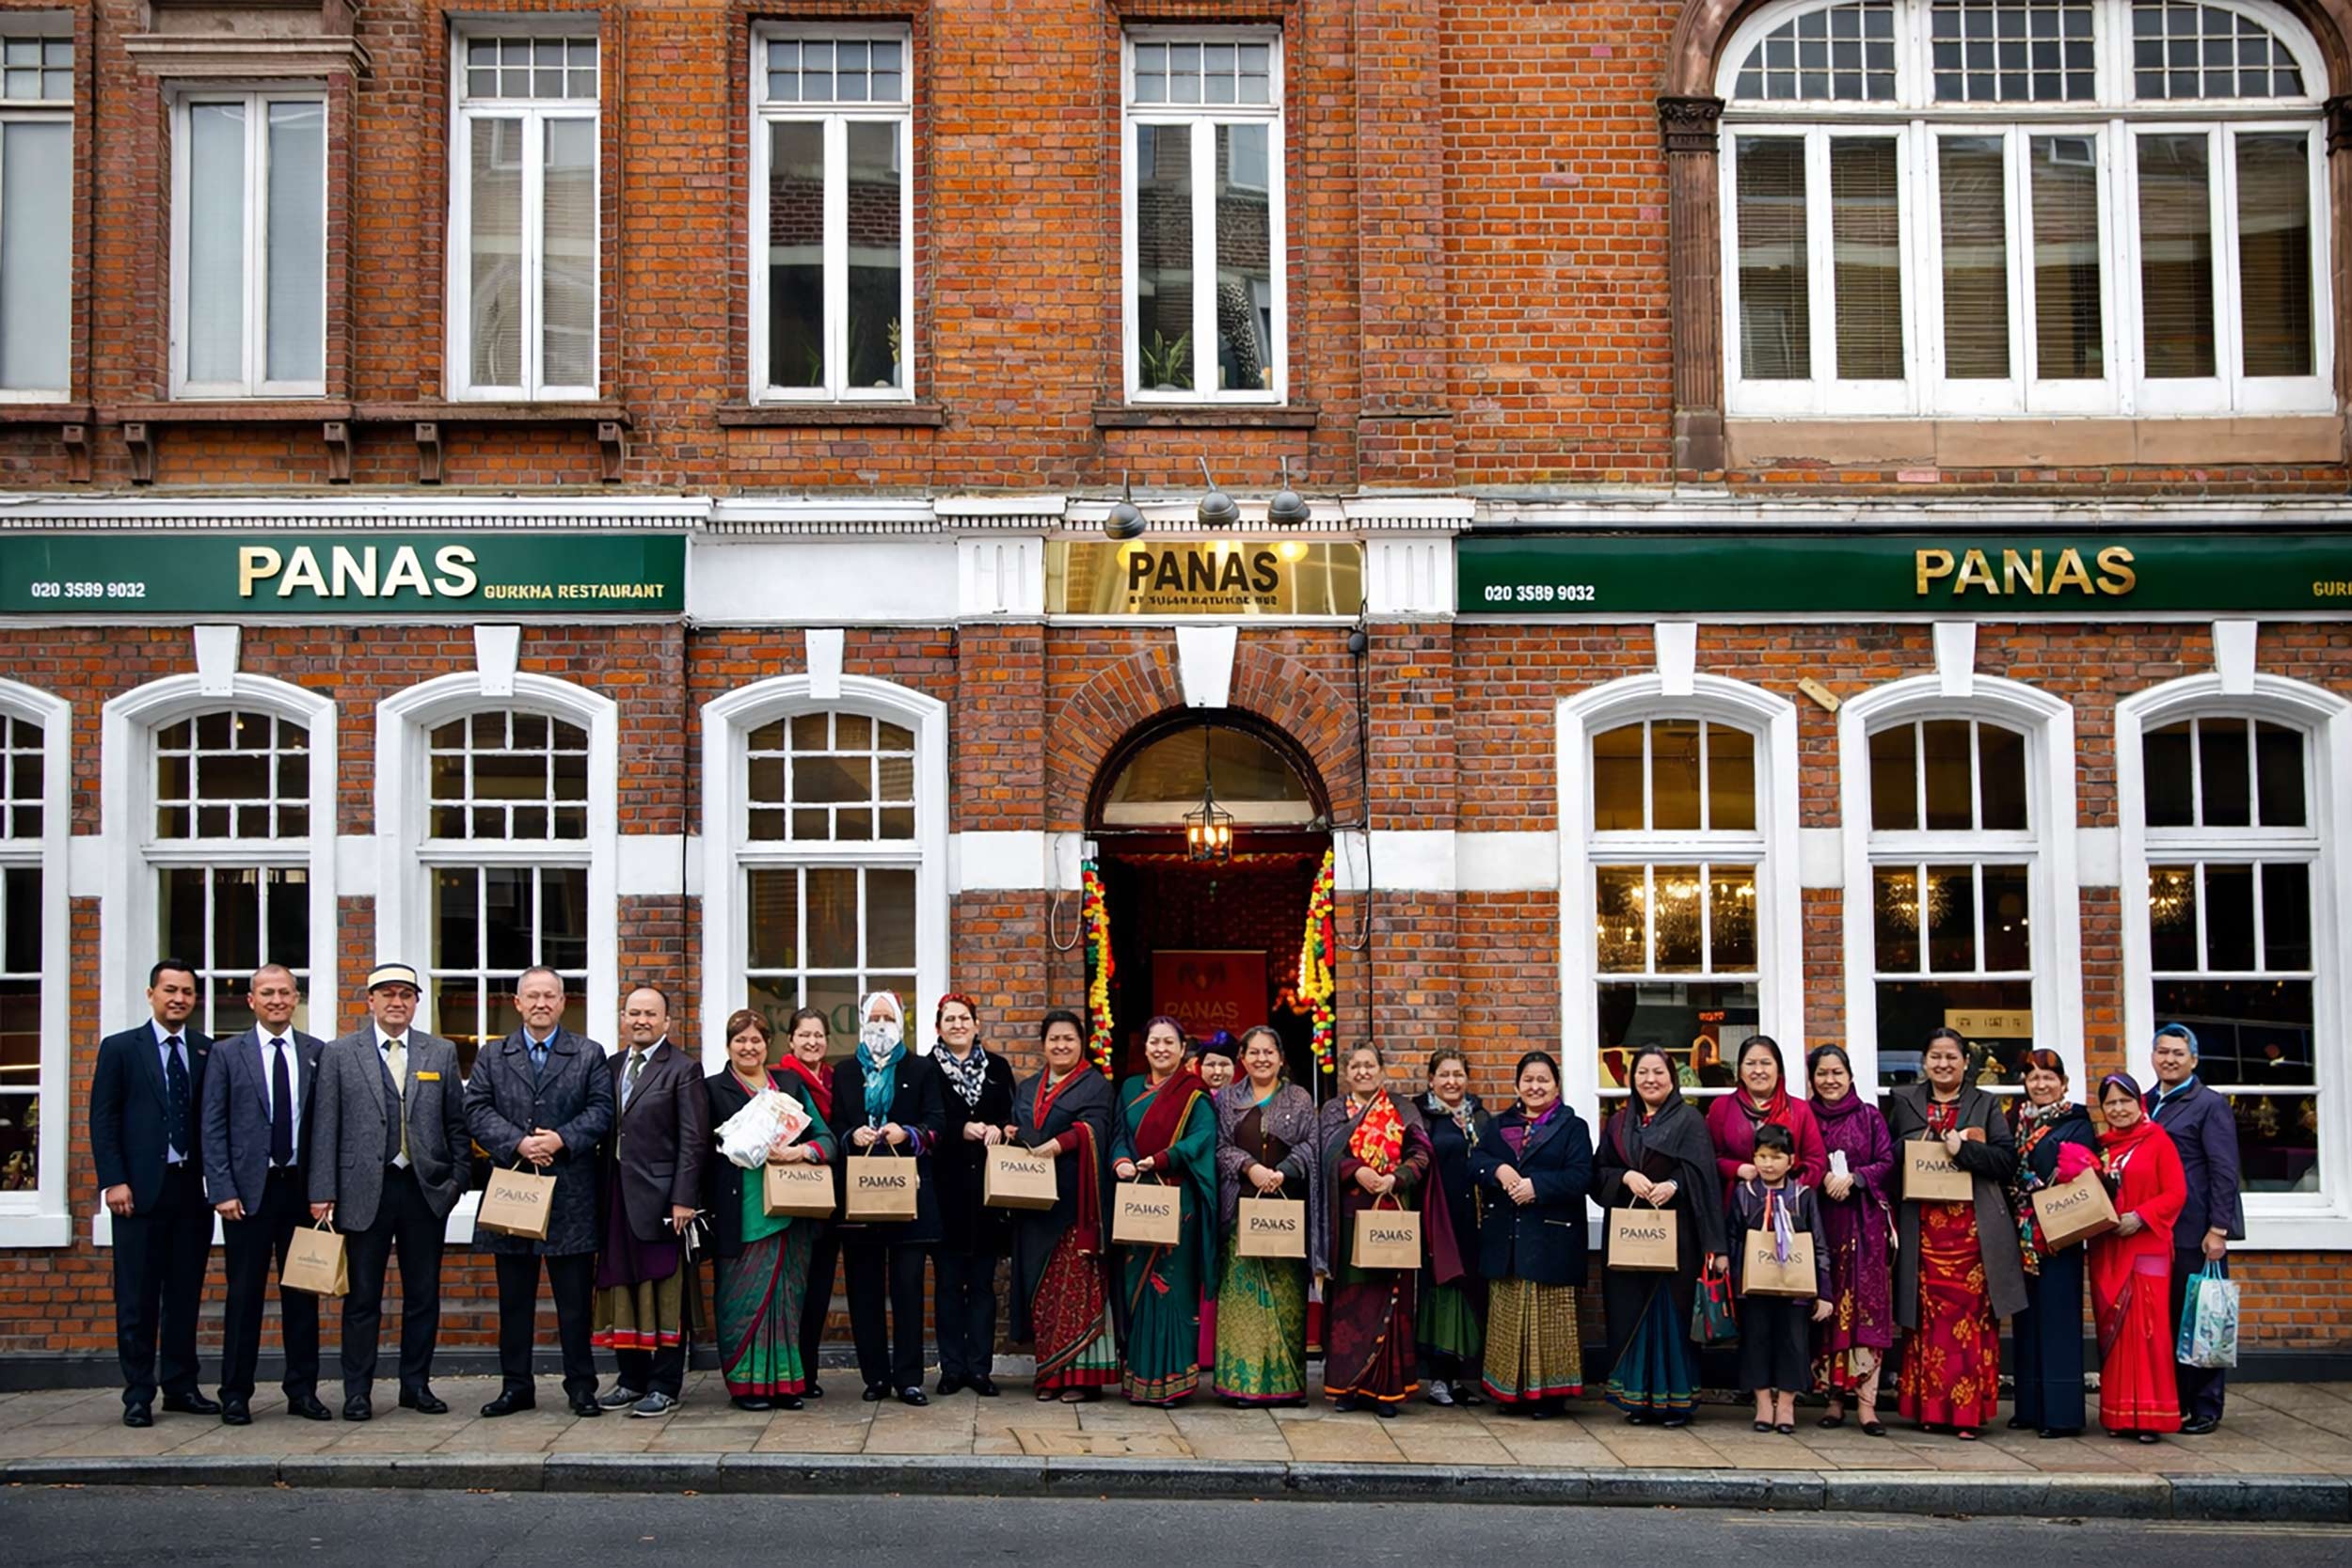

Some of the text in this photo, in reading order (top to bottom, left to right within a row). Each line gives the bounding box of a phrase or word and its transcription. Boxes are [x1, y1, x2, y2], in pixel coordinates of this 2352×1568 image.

[238, 546, 478, 597] PANAS
[1129, 550, 1279, 593] PANAS
[1915, 546, 2137, 594] PANAS
[31, 581, 146, 597] 020 3589 9032
[484, 584, 665, 599] GURKHA RESTAURANT
[1485, 585, 1596, 601] 020 3589 9032
[1164, 1001, 1239, 1020] PANAS
[1757, 1249, 1803, 1264] PAS
